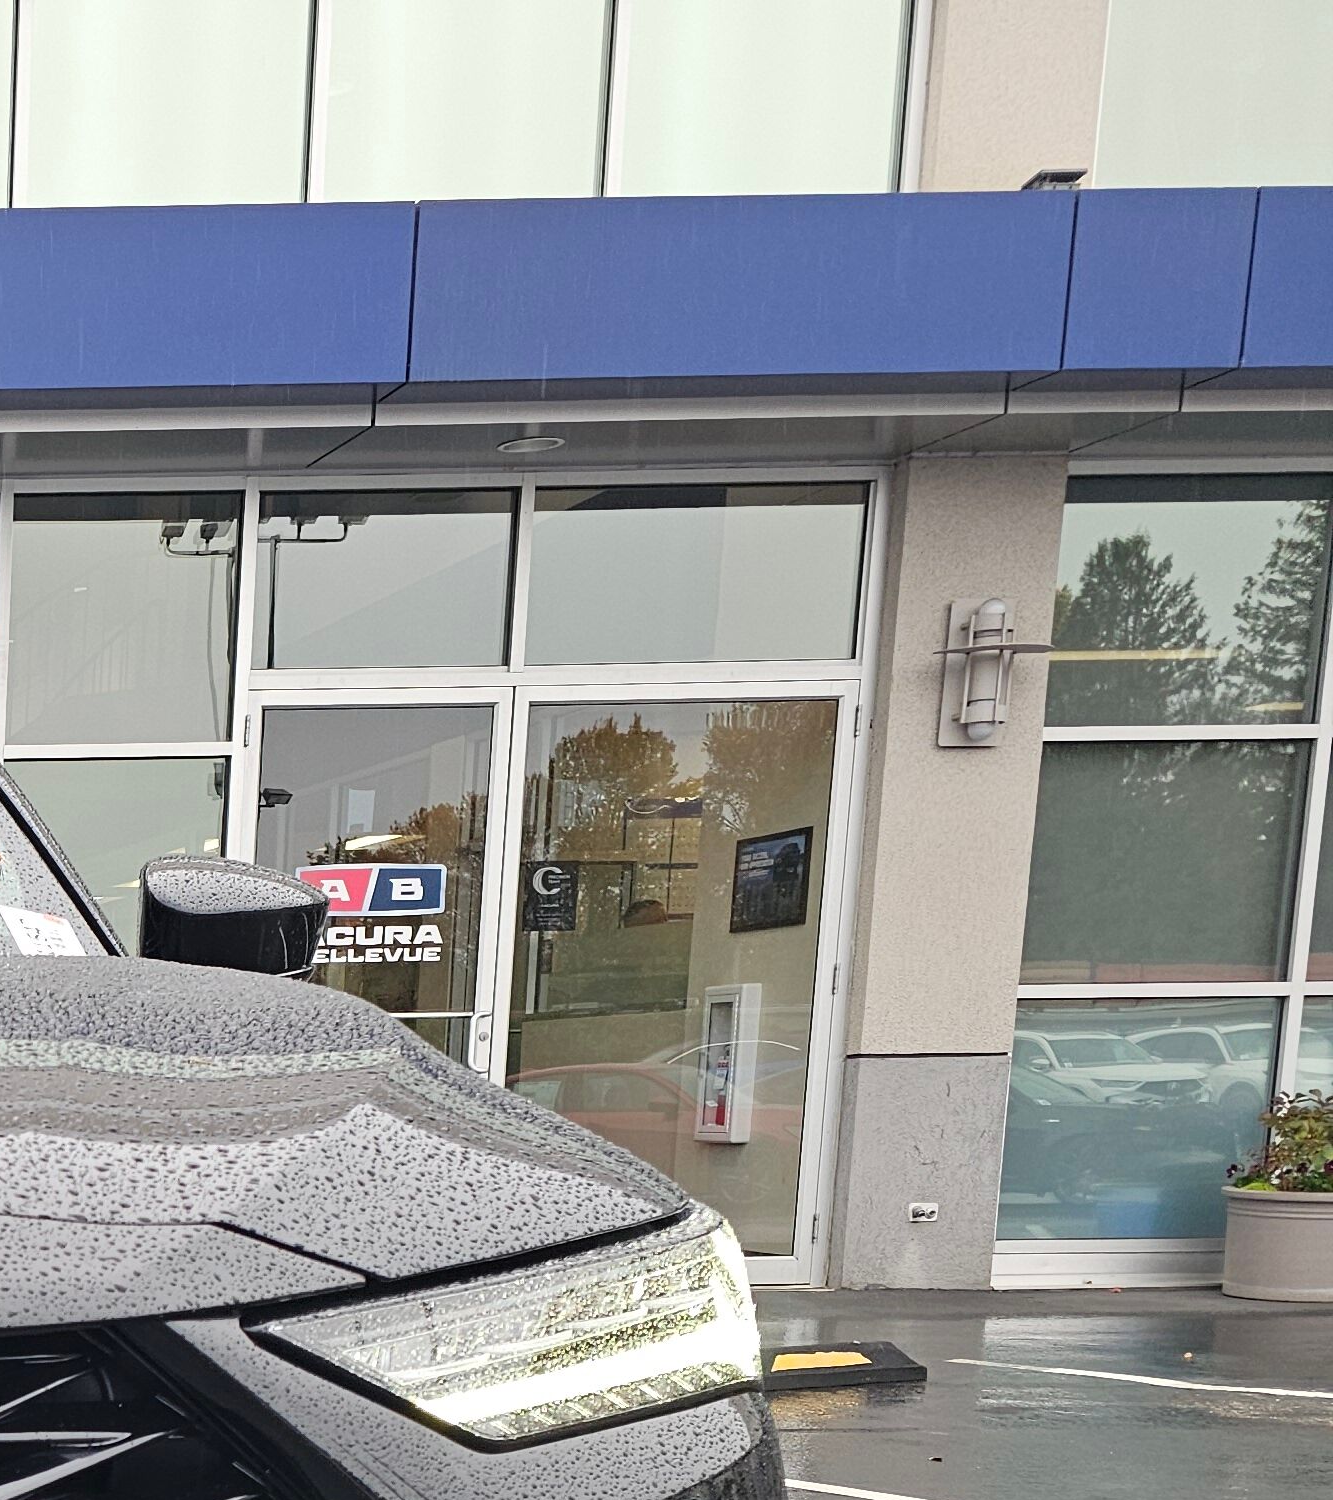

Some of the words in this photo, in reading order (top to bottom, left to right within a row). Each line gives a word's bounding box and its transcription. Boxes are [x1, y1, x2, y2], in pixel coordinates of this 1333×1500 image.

[320, 878, 351, 902] A
[388, 877, 424, 901] B
[318, 924, 443, 946] CURA
[311, 946, 442, 964] ELLEVUE
